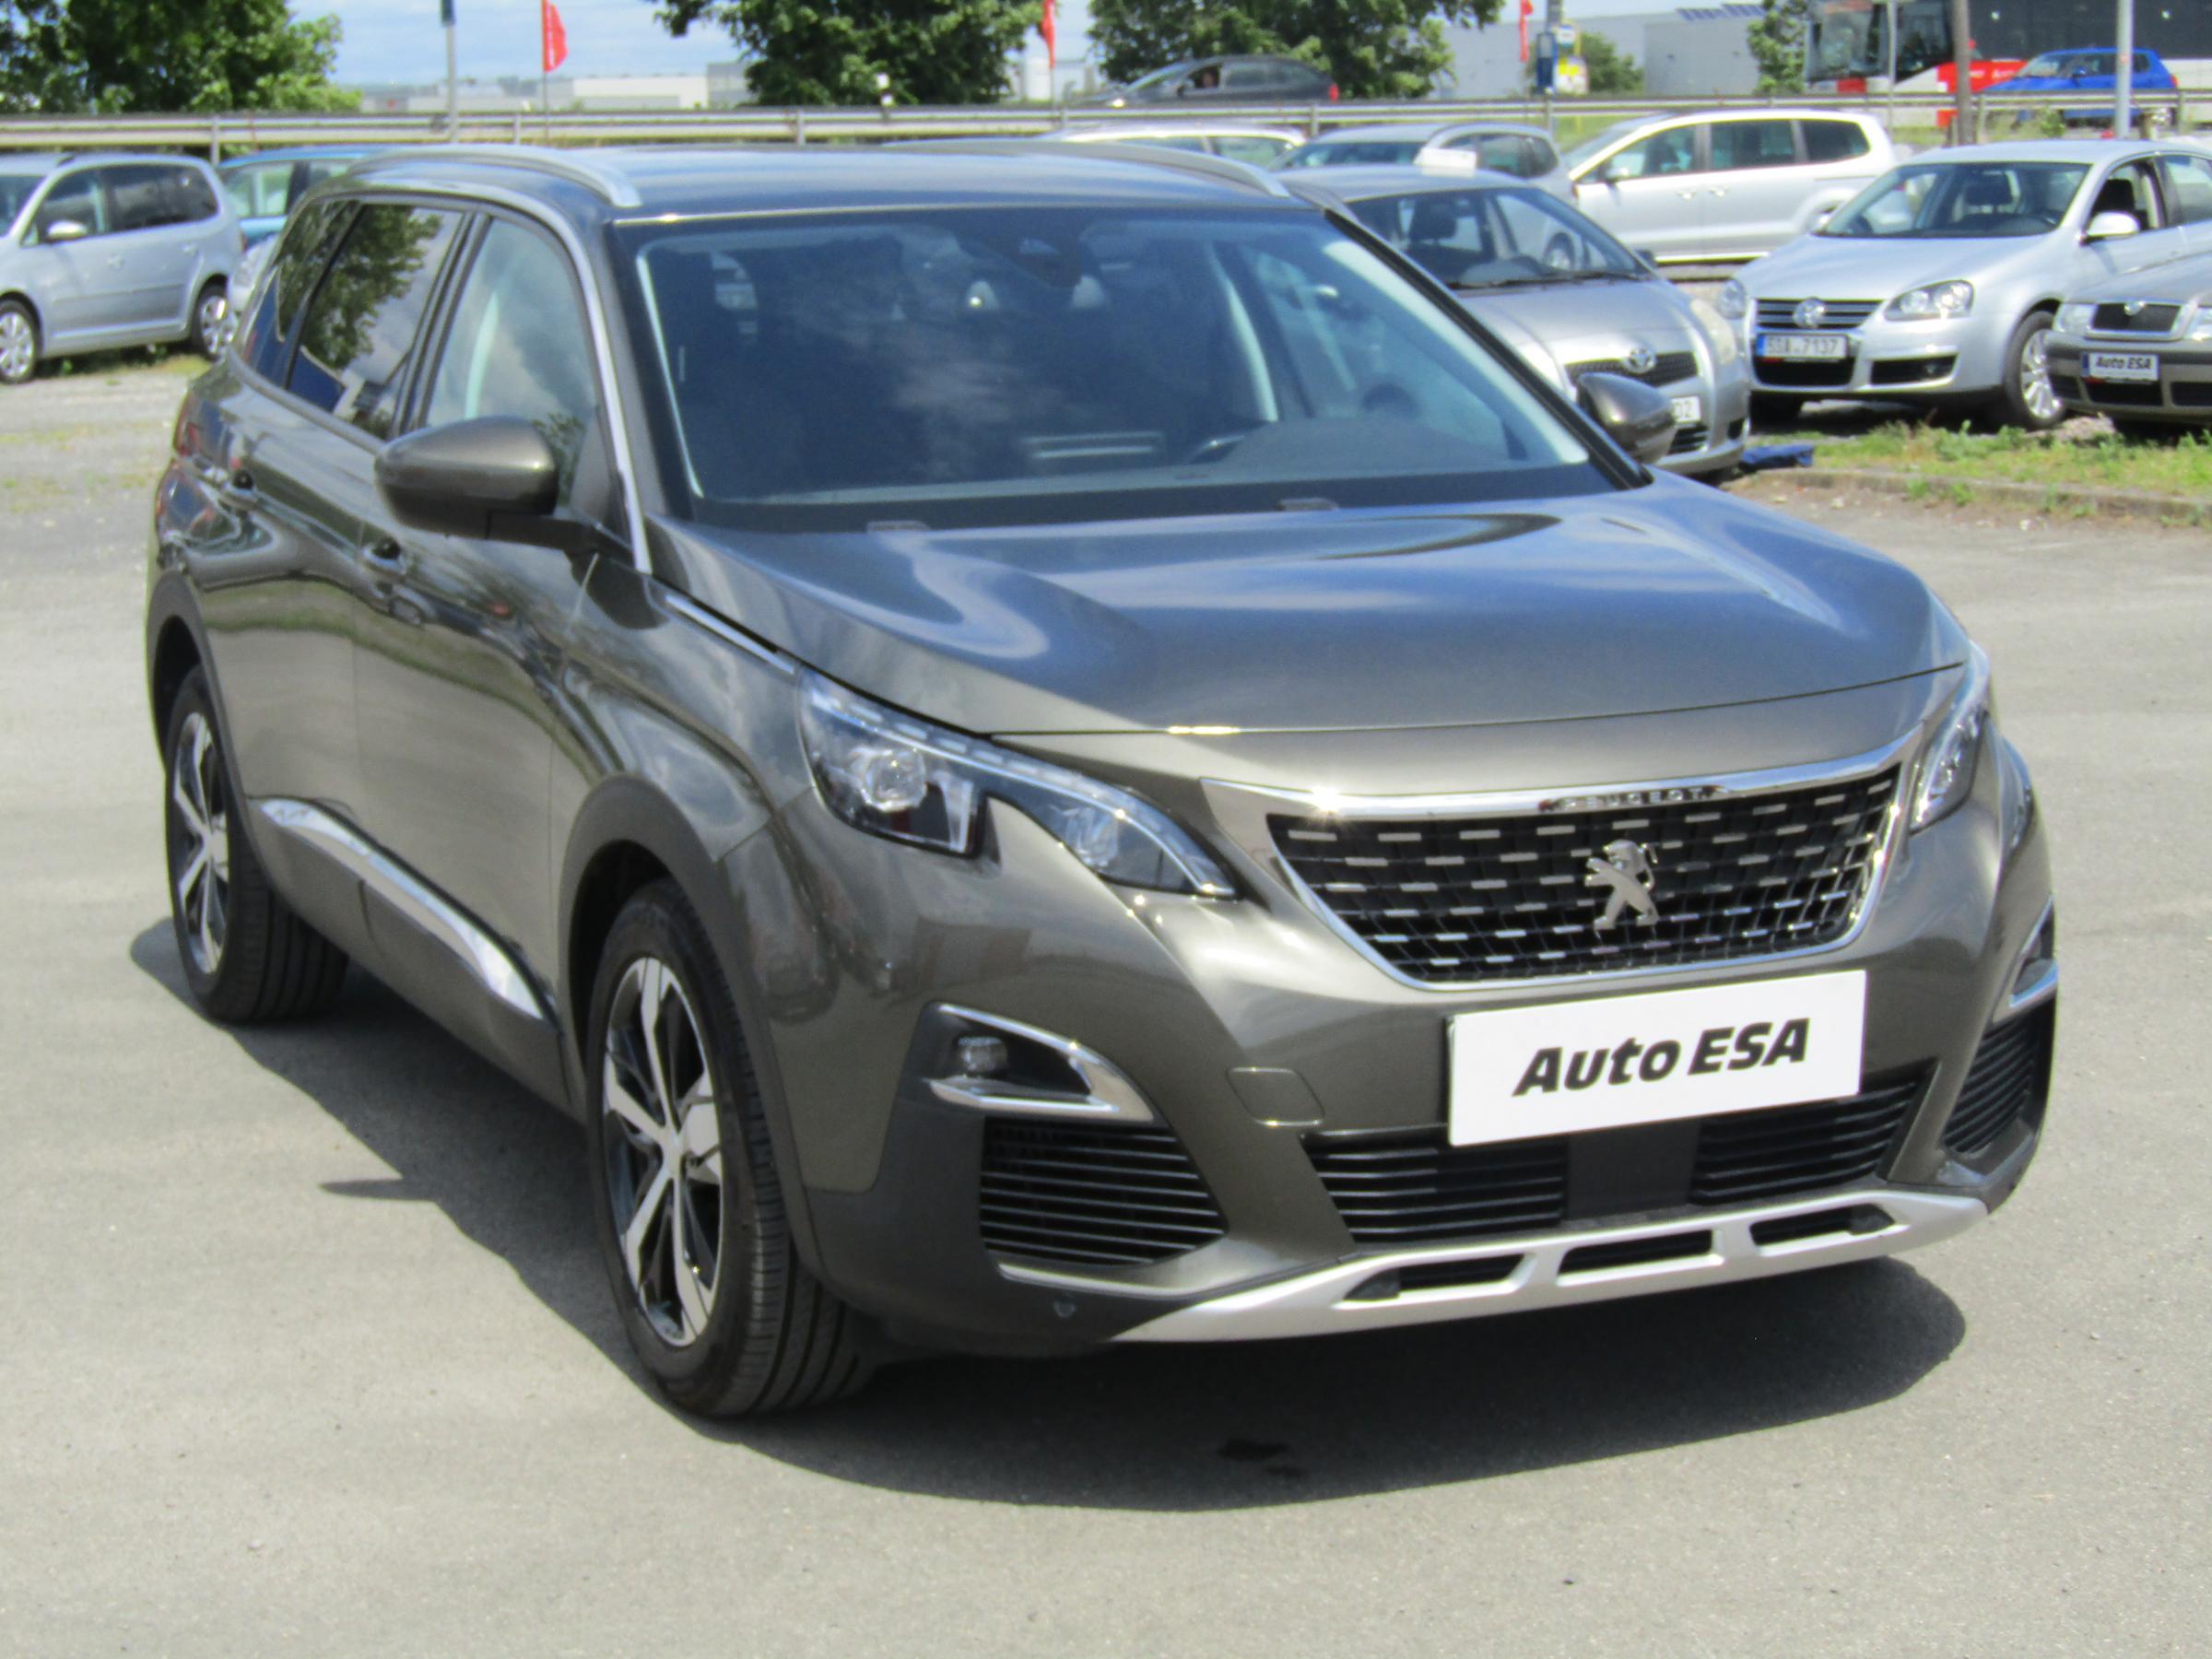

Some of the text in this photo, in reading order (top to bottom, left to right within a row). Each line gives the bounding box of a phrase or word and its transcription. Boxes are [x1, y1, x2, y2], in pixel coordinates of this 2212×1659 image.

[2095, 357, 2151, 370] Auto ESA
[1562, 786, 1705, 811] PEUGEOT
[1512, 1017, 1811, 1098] Auto ESA
